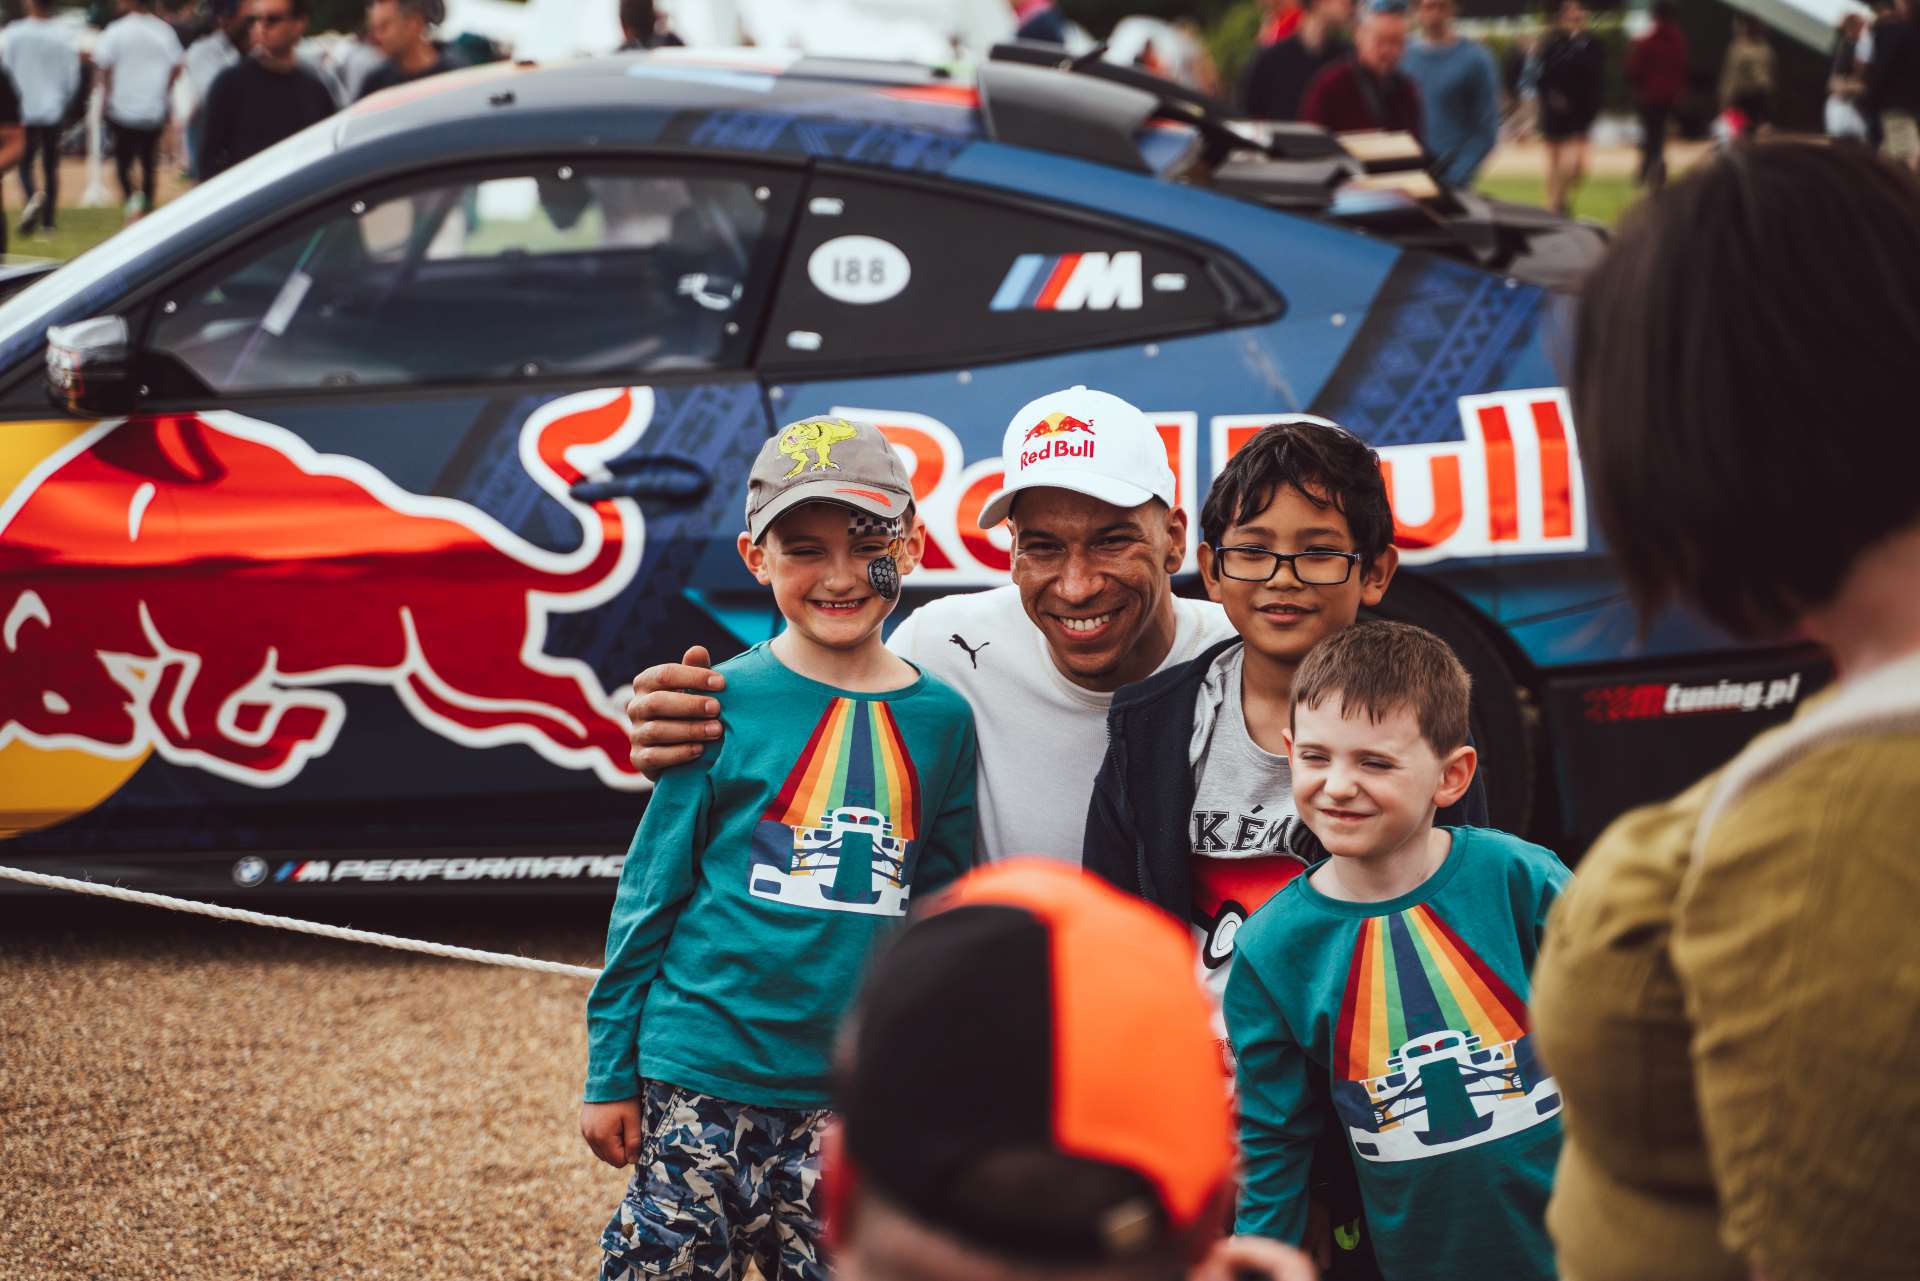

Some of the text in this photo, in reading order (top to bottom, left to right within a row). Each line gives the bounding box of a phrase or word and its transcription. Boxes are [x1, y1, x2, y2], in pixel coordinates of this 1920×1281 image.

[831, 256, 887, 286] 188
[1055, 251, 1144, 310] M
[1020, 440, 1095, 471] Red Bull
[1224, 398, 1577, 556] ull
[331, 855, 627, 881] PERFORMANC
